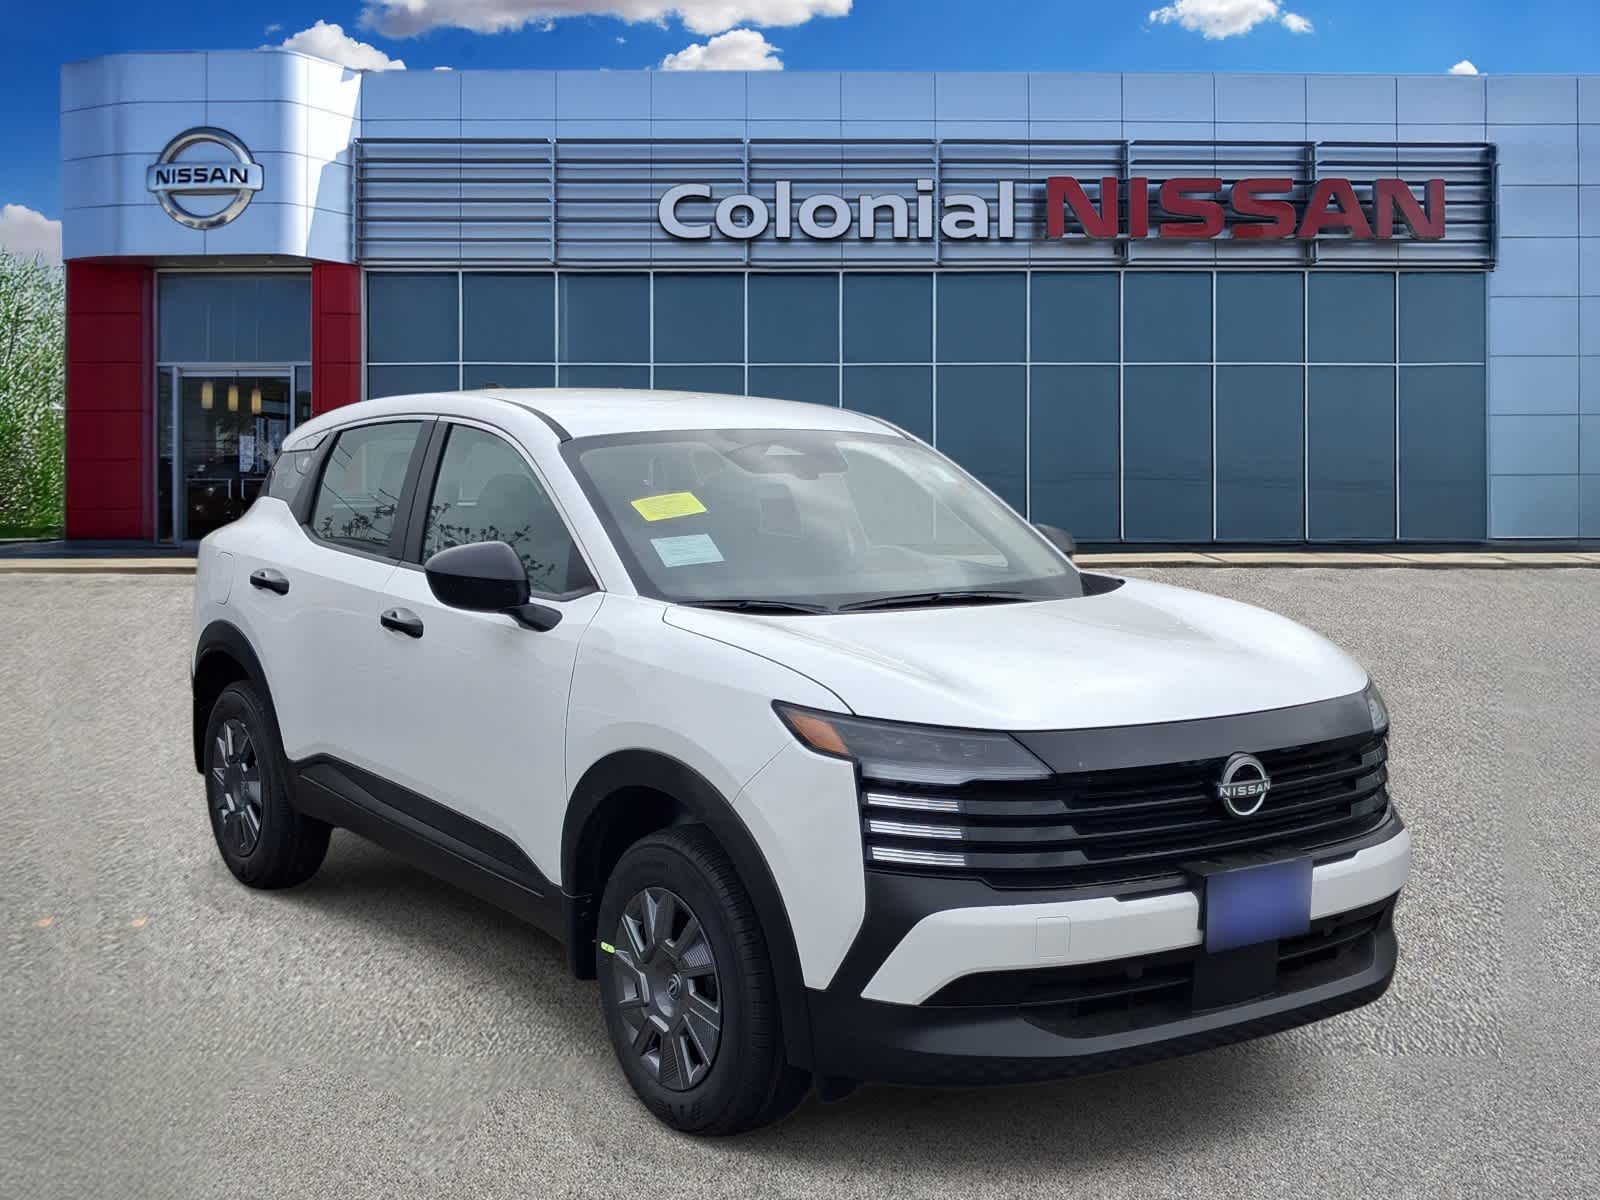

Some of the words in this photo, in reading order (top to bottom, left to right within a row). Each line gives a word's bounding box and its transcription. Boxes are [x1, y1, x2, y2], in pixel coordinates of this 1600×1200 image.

[156, 167, 249, 185] NISSAN
[658, 179, 1014, 240] Colonial
[1045, 176, 1446, 241] NISSAN
[1220, 781, 1271, 797] NISSAN
